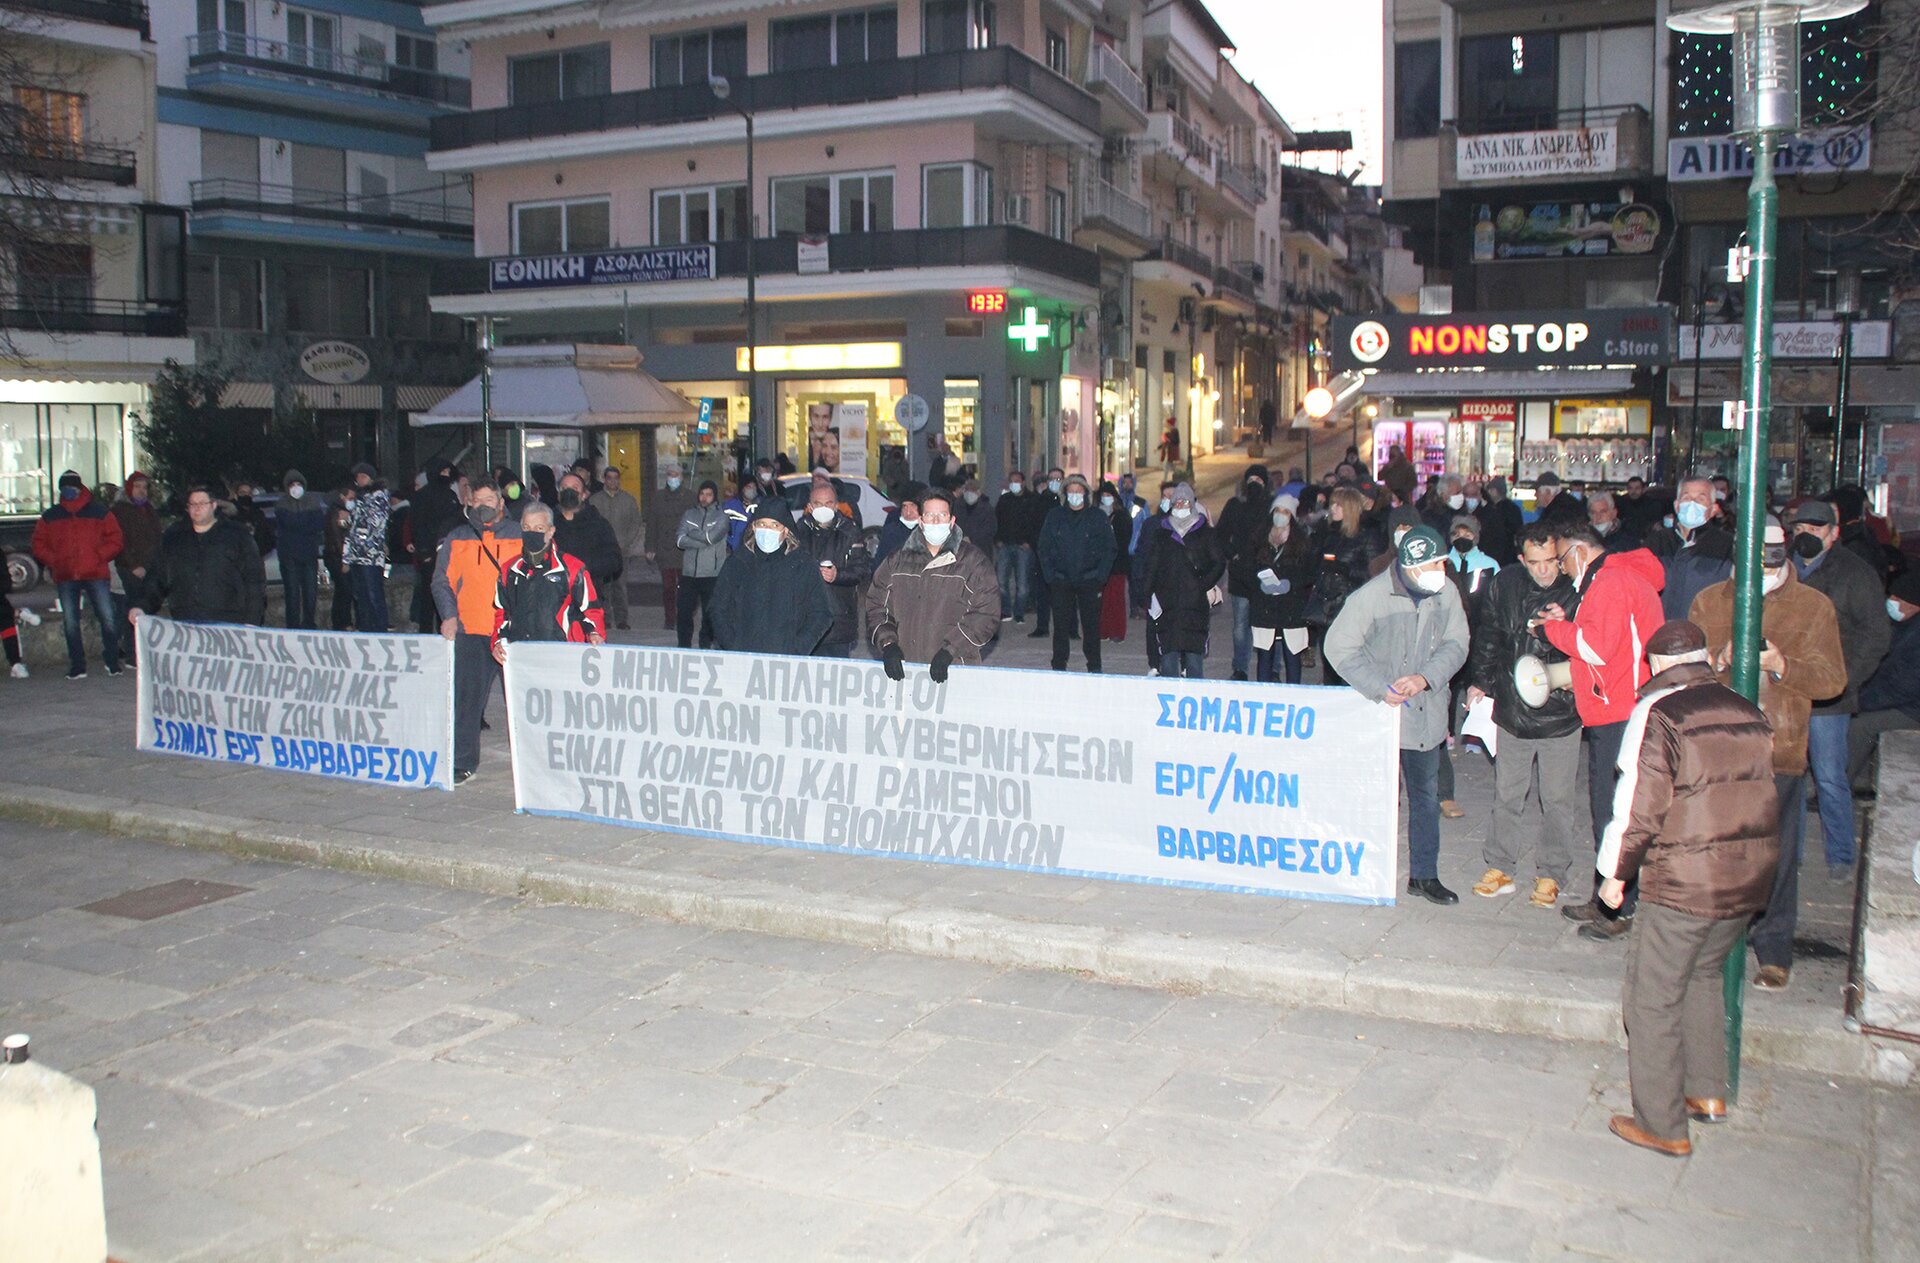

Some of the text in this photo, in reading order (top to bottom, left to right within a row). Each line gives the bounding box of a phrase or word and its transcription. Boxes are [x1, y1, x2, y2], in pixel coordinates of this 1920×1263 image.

[1465, 139, 1498, 160] ΑΝΝΑ
[1531, 132, 1609, 155] ΑΝΔΡΕΑΔΟΥ
[1472, 156, 1600, 175] ΣΥΜΒΟΛΑΙΟΓΡΑΦΟΣ
[494, 250, 708, 282] ΕΘΝΙΚΗ ΑΣΦΑΛΙΣΤΙΚΗ
[1604, 339, 1659, 357] C-Store
[841, 408, 865, 416] VICHY
[1462, 403, 1514, 416] ΕΙΣΟΔΟΣ
[255, 632, 296, 664] ΓΙΑ
[297, 635, 352, 669] ΤΗΝ
[580, 647, 602, 686] 6
[612, 650, 724, 698] ΜΗΝΕΣ
[187, 656, 235, 692] ΤΗΝ
[233, 660, 346, 704] ΠΛΗΡΩΜΗ
[348, 673, 398, 709] ΜΑΣ
[151, 684, 390, 746] ΑΦΟΡΑ ΤΗΝ ΖΩΗ ΜΑΣ
[525, 687, 1134, 785] ΟΙ ΝΟΜΟΙ ΟΛΩΝ ΤΩΝ ΚΥΒΕΡΝΗΣΕΩΝ
[1154, 692, 1317, 741] ΣΩΜΑΤΕΙΟ
[274, 736, 438, 786] ΒΑΡΒΑΡΕΣΟΥ
[546, 732, 1032, 821] ΕΙΝΑΙ ΚΟΜΕΝΟΙ ΚΑΙ ΡΑΜΕΝΟΙ
[1153, 750, 1300, 816] ΕΡΓ/ΝΩΝ
[579, 776, 1065, 868] ΣΤΑ ΘΕΛΩ ΤΩΝ ΒΙΟΜΗΧΑΝΩΝ
[1155, 823, 1367, 878] ΒΑΡΒΑΡΕΣΟΥ
